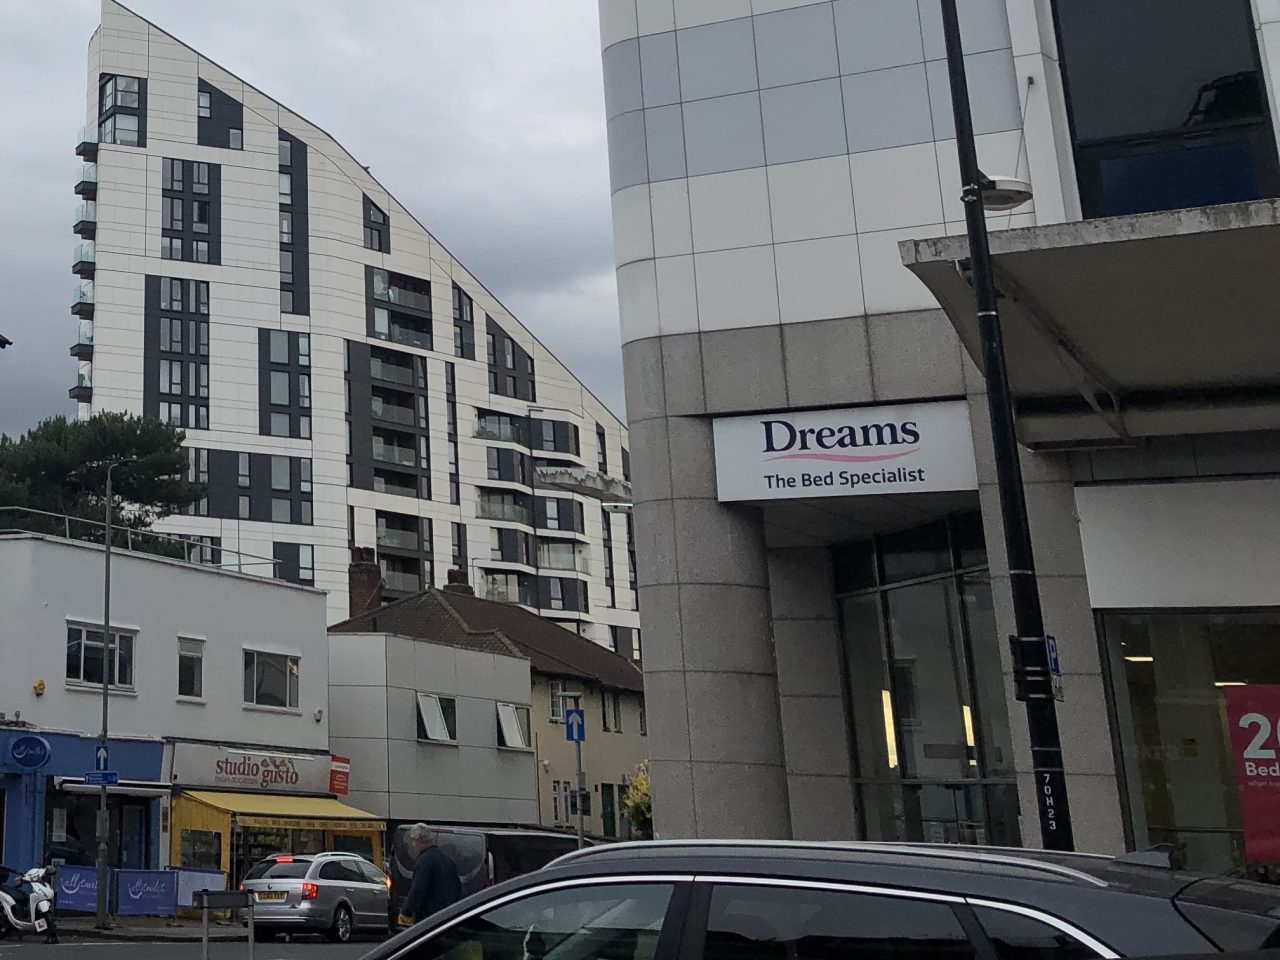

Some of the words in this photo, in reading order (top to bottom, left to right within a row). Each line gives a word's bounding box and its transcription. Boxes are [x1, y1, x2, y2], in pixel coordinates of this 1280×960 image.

[760, 420, 920, 453] Dreams
[764, 474, 796, 489] The
[801, 472, 834, 487] Bed
[839, 467, 926, 488] Specialist
[1238, 712, 1280, 759] 2
[215, 756, 260, 777] studio
[260, 765, 299, 788] gusto
